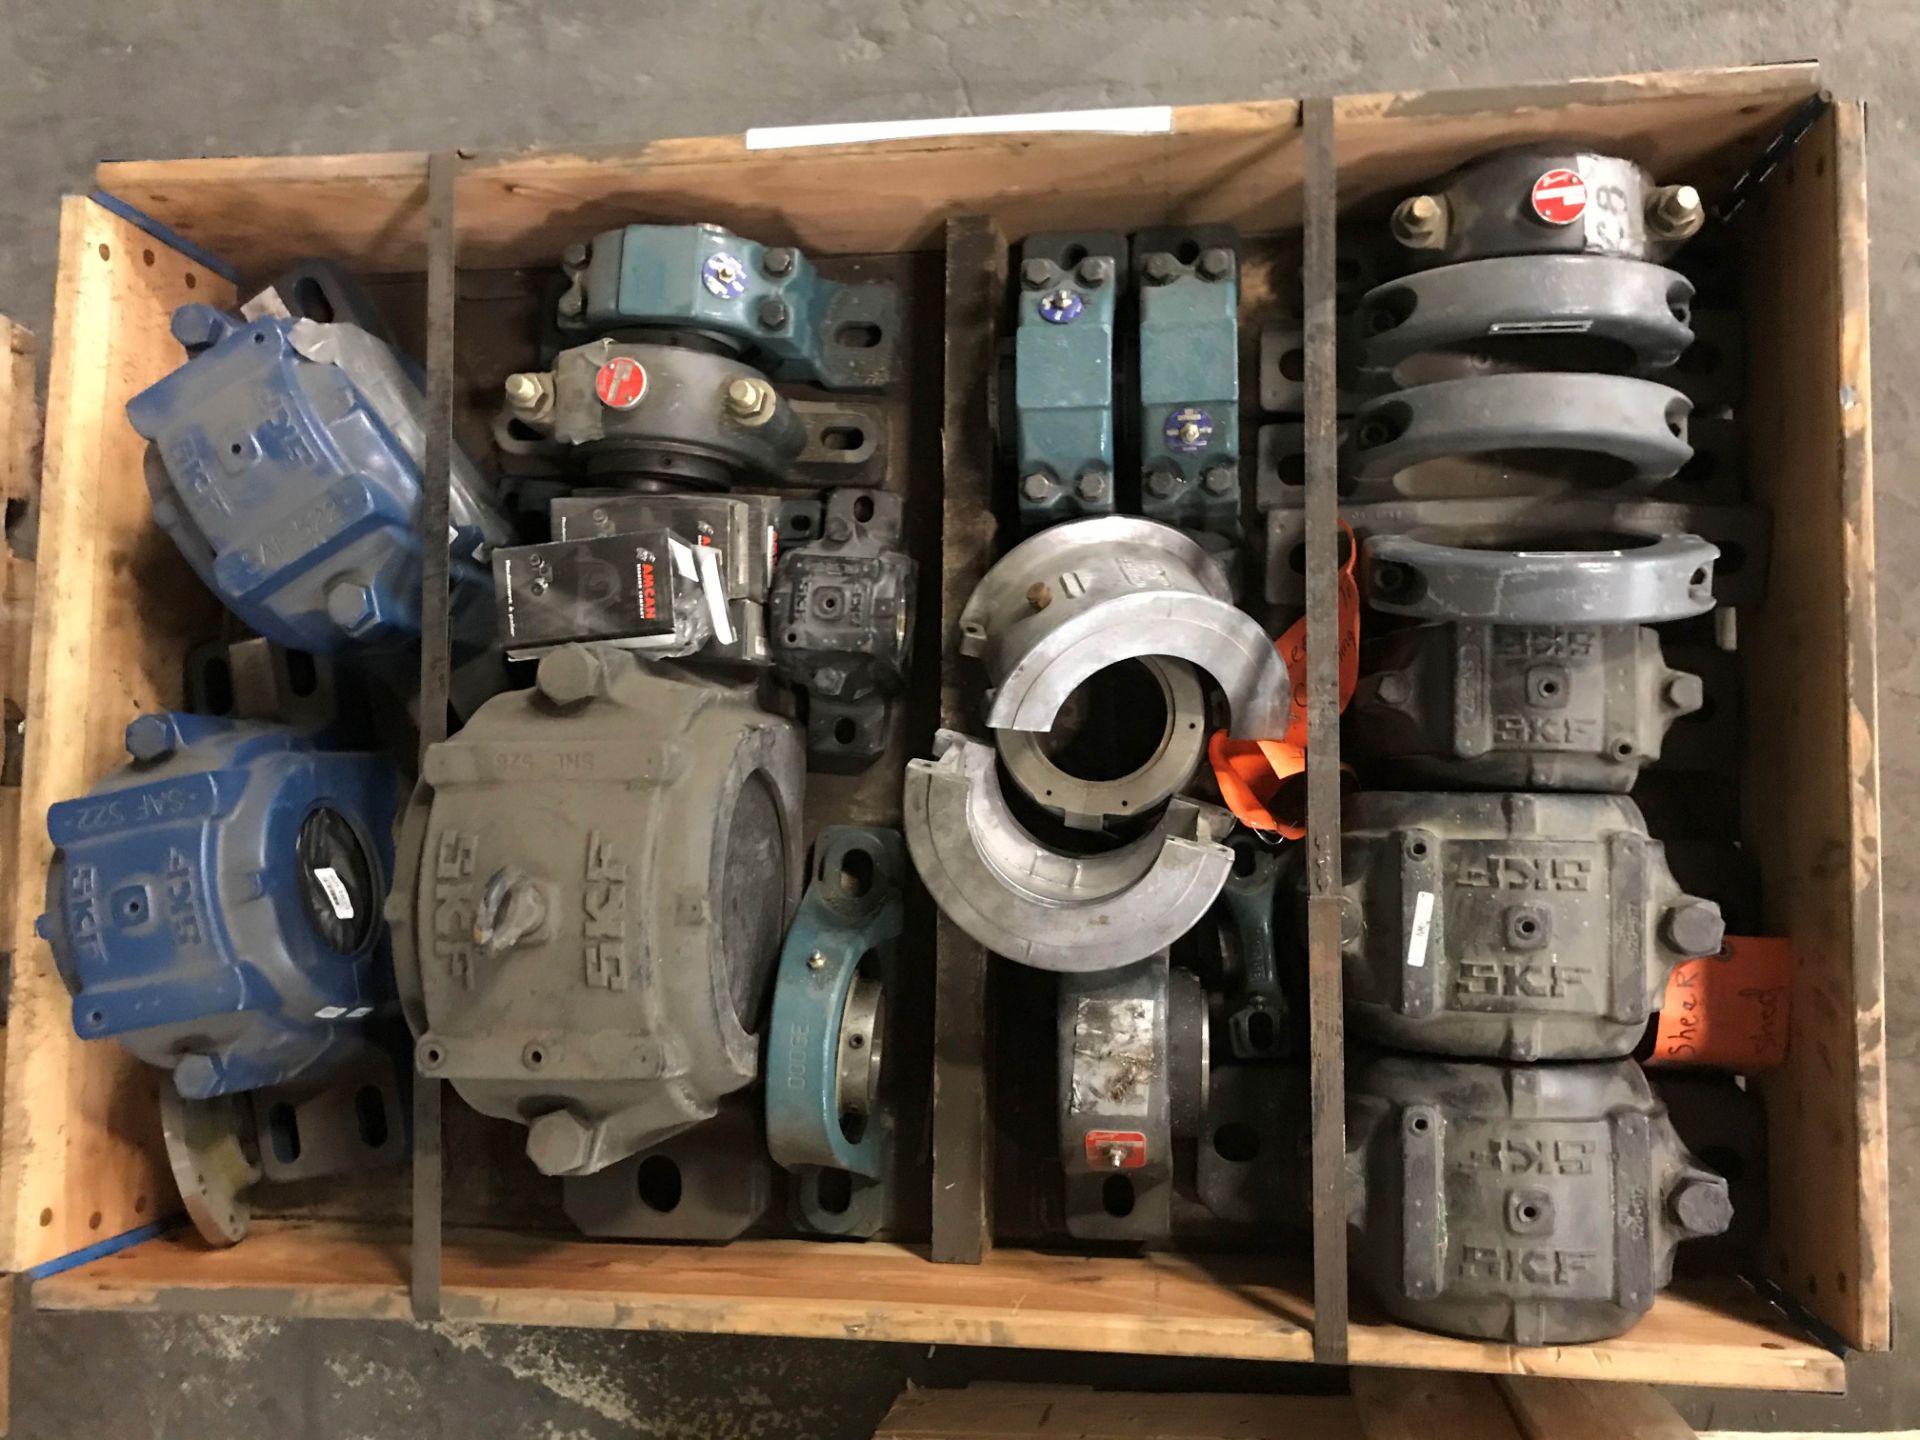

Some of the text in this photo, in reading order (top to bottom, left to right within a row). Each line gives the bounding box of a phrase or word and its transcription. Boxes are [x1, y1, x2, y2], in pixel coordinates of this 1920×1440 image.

[641, 563, 656, 619] AMCAN
[166, 846, 204, 945] SKF
[583, 830, 628, 993] SKF
[1456, 857, 1592, 892] SKF
[72, 864, 109, 963] SKF
[1456, 962, 1593, 999] SKF
